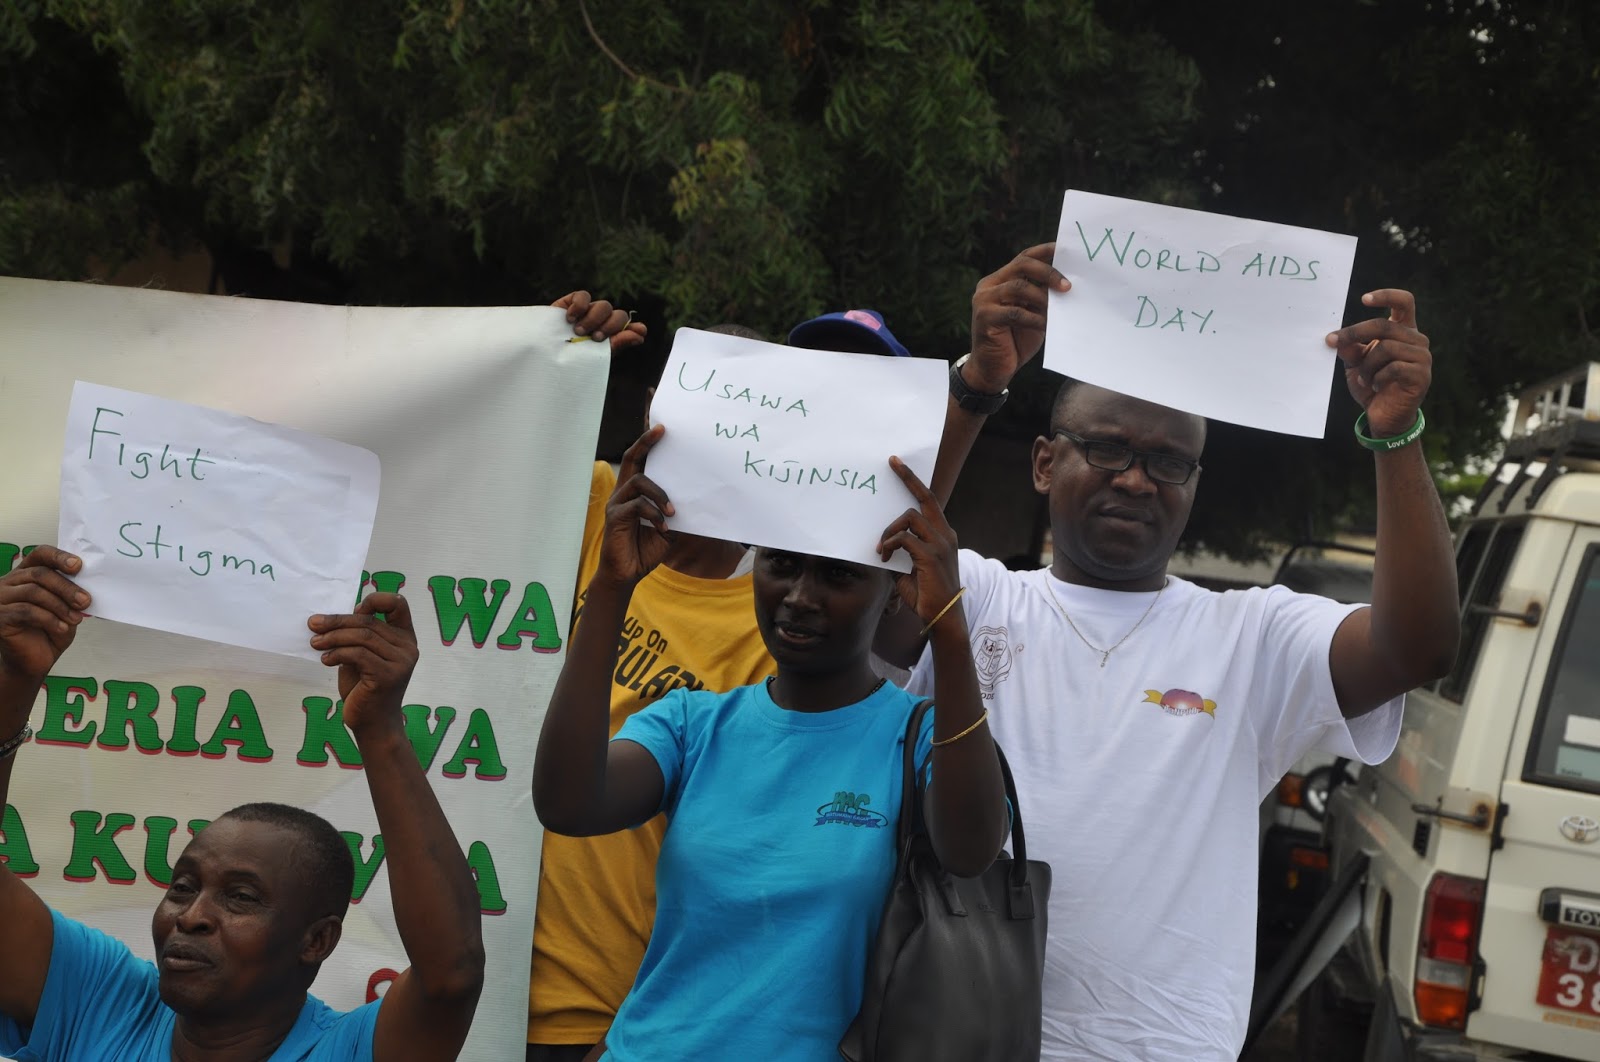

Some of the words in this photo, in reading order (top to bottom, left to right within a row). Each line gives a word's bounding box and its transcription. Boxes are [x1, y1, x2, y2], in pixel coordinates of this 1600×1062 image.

[1076, 221, 1220, 273] WORLD
[1242, 252, 1321, 281] AIDS
[1134, 295, 1217, 335] DAY.
[678, 362, 810, 418] USAWA
[88, 407, 217, 481] Fight
[714, 422, 761, 443] WA
[1386, 438, 1406, 449] Love
[743, 450, 878, 495] KIJINSIA
[117, 521, 277, 582] Stigma
[428, 575, 563, 653] WA
[646, 629, 669, 654] On
[25, 676, 274, 763] ERIA
